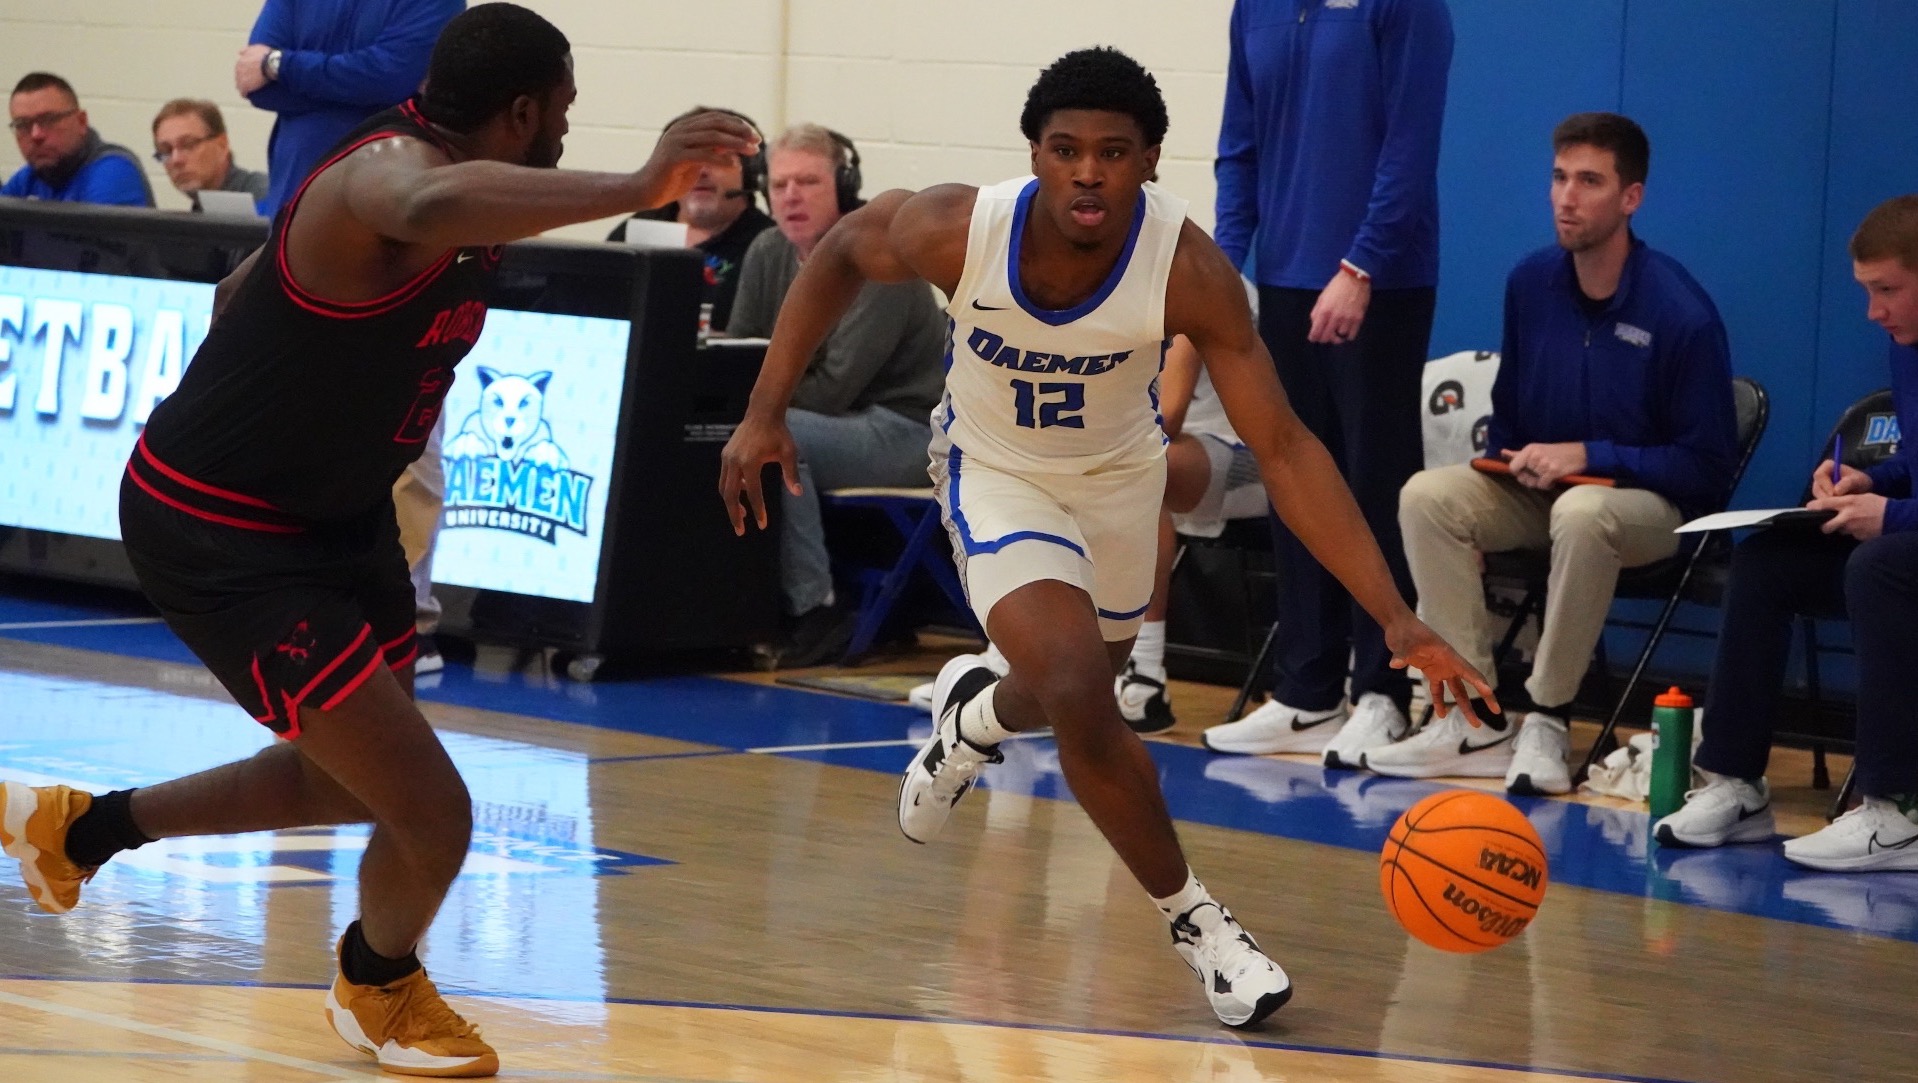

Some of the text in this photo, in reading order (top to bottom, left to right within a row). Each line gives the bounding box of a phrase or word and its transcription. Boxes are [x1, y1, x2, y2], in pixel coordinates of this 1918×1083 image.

[0, 294, 212, 425] ETBA
[1010, 378, 1085, 429] 12
[441, 457, 591, 532] AEMEN
[445, 507, 552, 538] UNIVERSITY
[1480, 848, 1542, 891] NCAA
